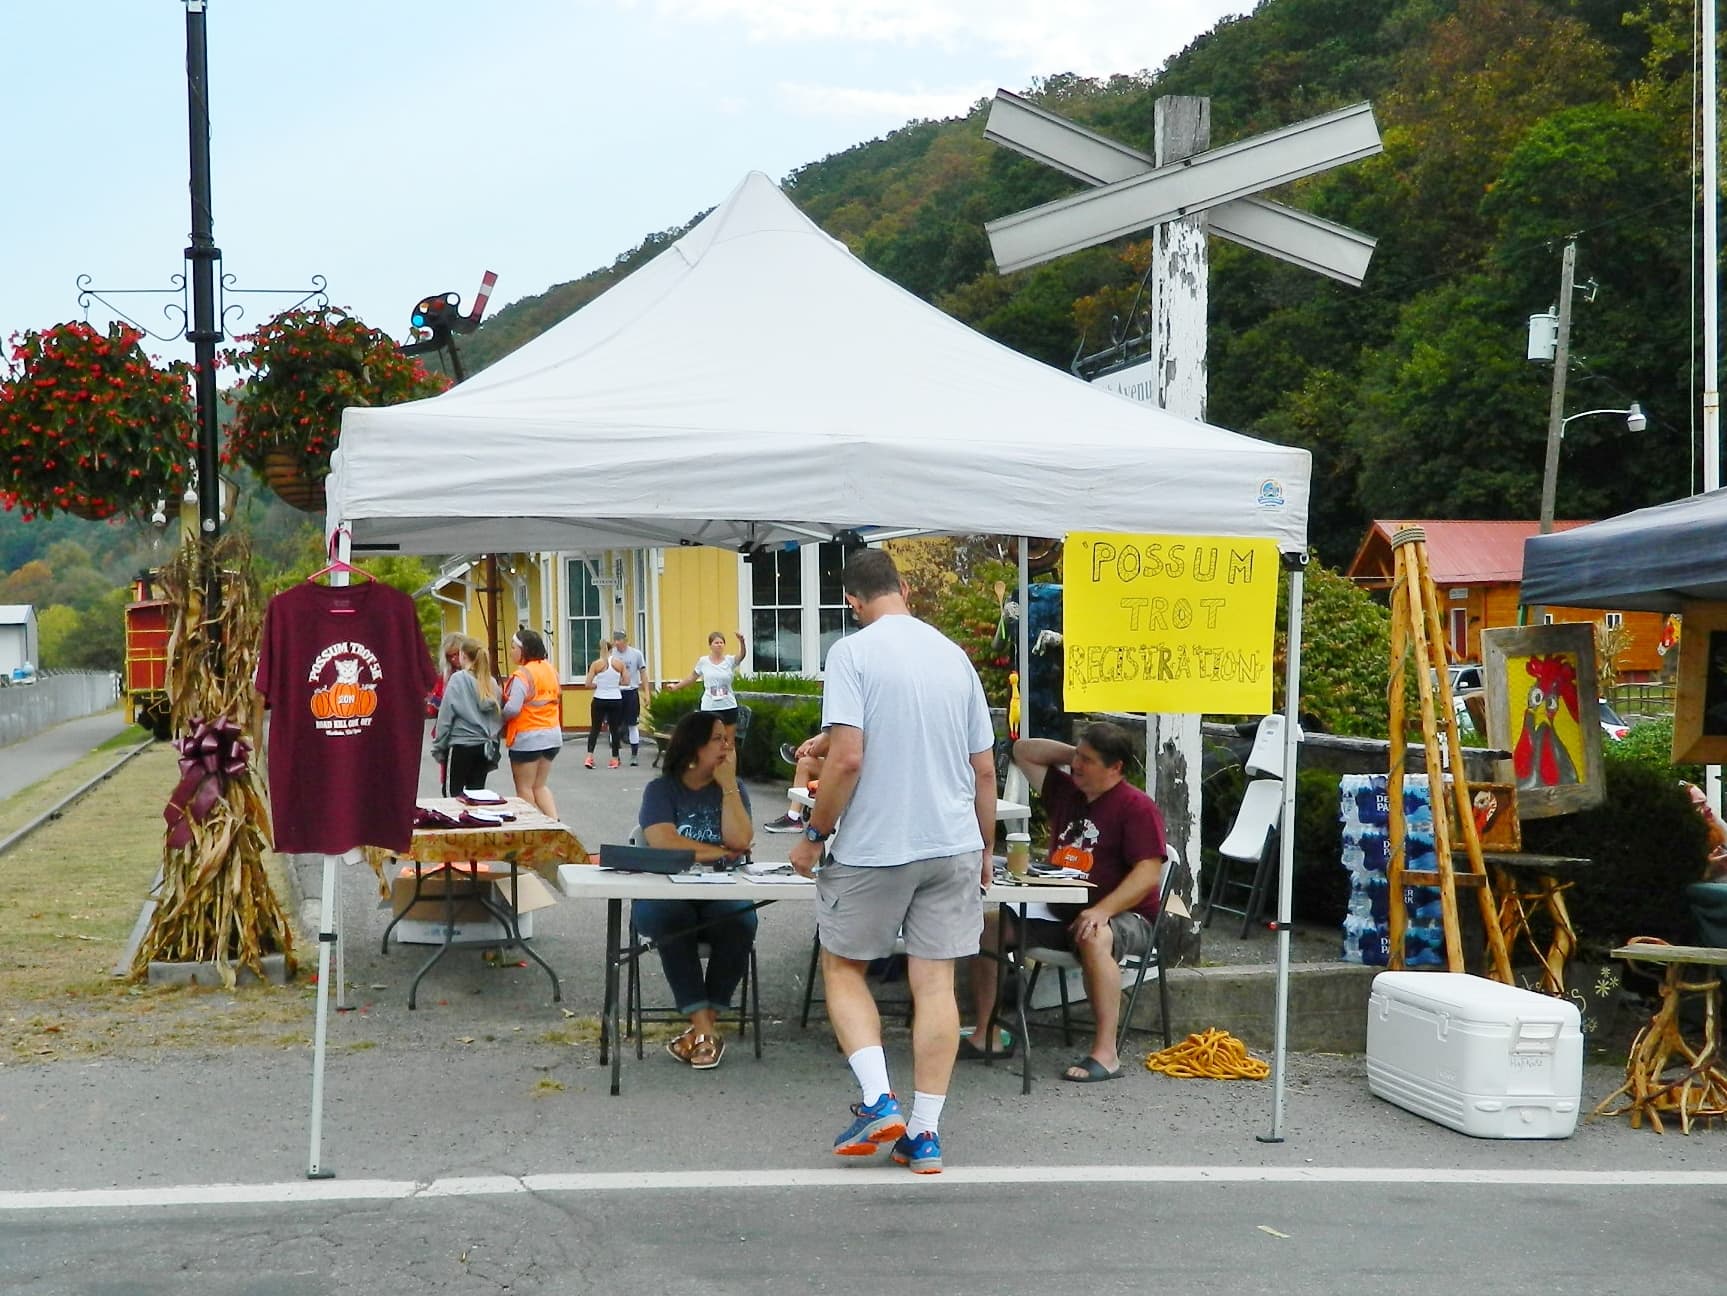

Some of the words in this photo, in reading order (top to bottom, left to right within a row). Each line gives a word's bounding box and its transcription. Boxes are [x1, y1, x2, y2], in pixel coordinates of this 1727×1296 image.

[1117, 380, 1152, 400] Avenu
[1092, 541, 1254, 584] POSSUM
[1120, 597, 1226, 631] TROT
[308, 642, 348, 682] POSSUM
[350, 642, 378, 665] TROT
